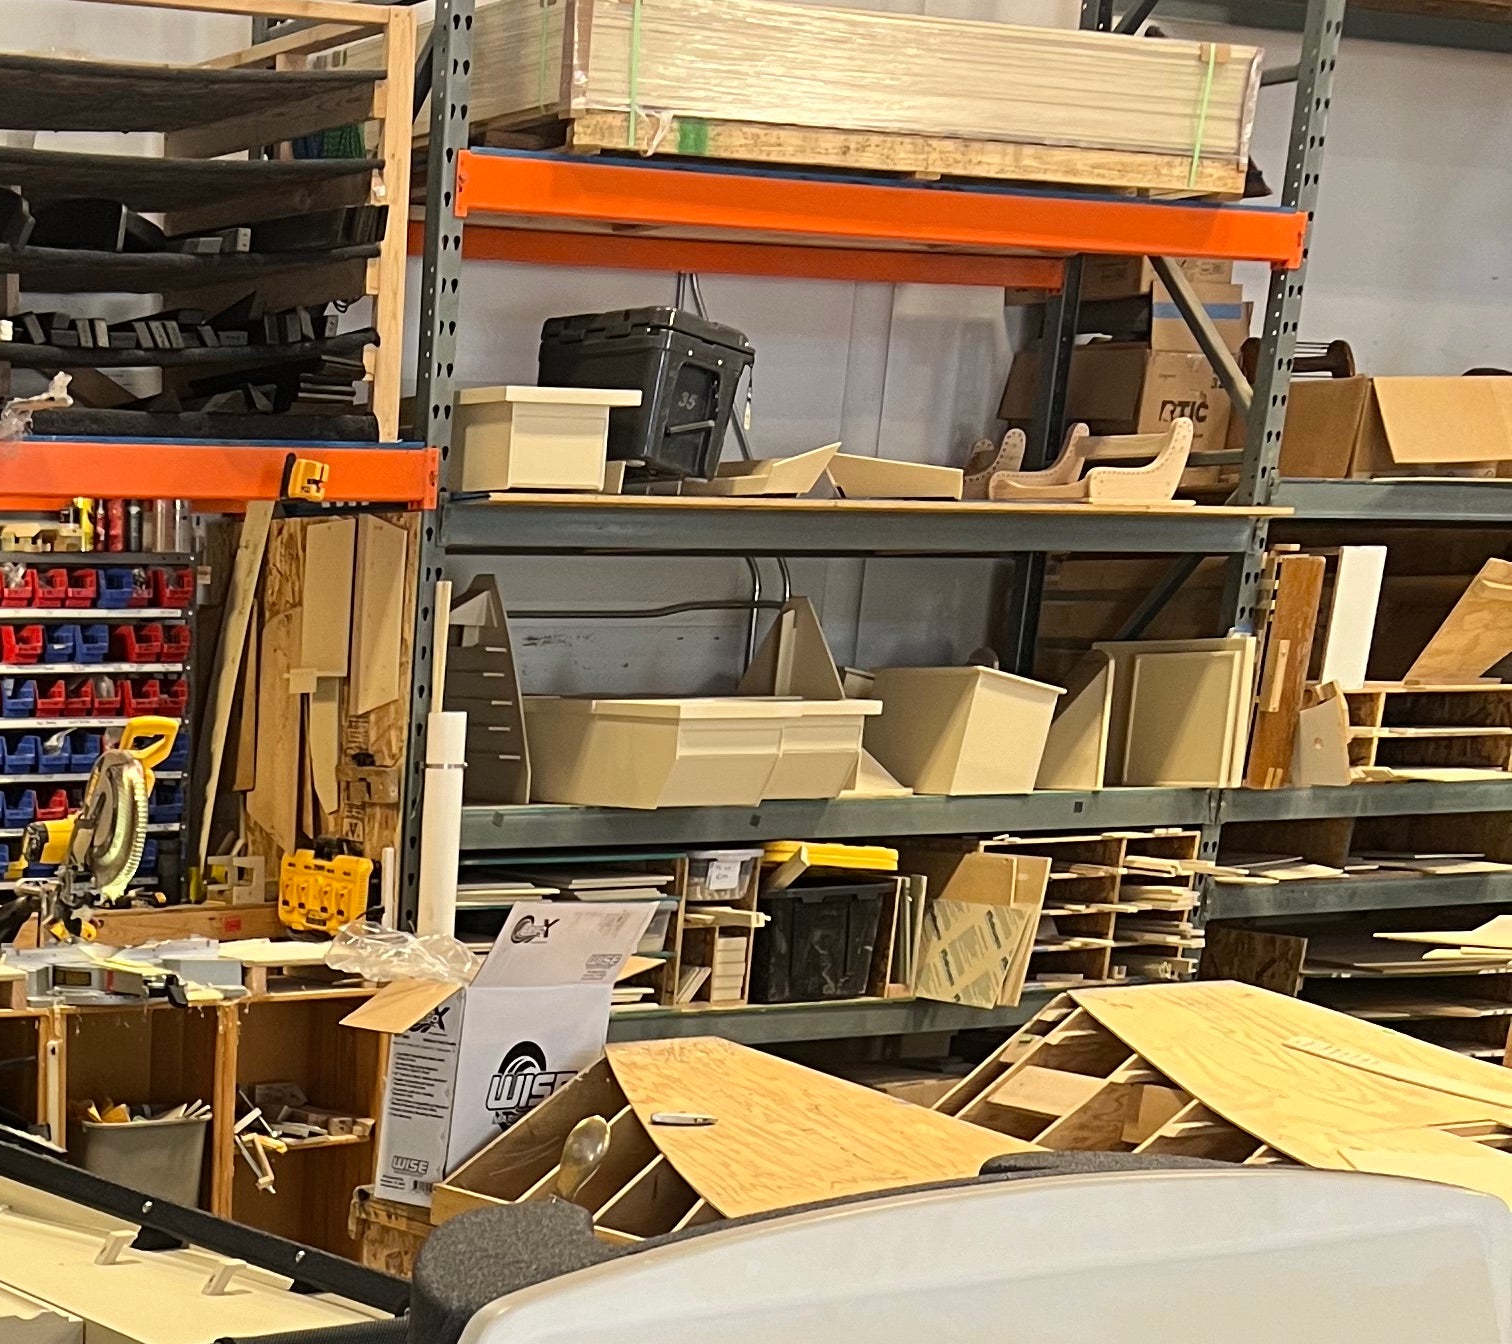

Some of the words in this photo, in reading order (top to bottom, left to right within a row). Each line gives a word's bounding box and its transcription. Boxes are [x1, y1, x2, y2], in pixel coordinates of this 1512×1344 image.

[678, 391, 698, 410] 35
[1159, 400, 1209, 423] RTIC
[392, 1155, 429, 1174] WISE
